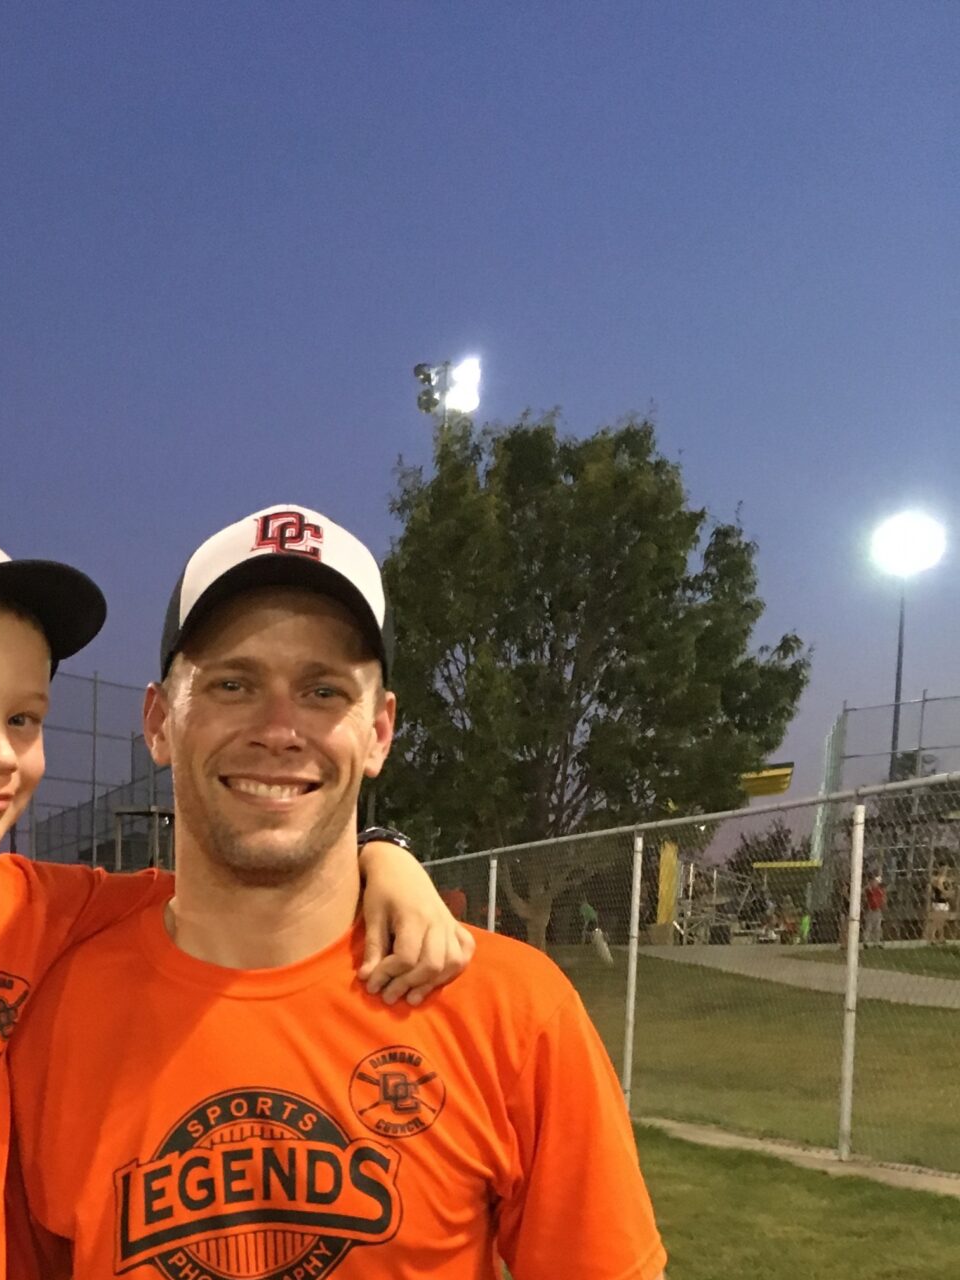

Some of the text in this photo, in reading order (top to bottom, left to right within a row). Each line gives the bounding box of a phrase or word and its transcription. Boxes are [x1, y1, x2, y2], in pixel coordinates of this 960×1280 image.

[252, 511, 323, 562] DC
[368, 1051, 423, 1069] DIAMOND
[186, 1097, 319, 1138] SPORTS
[375, 1116, 426, 1134] COUNCIL
[120, 1146, 393, 1263] LEGENDS
